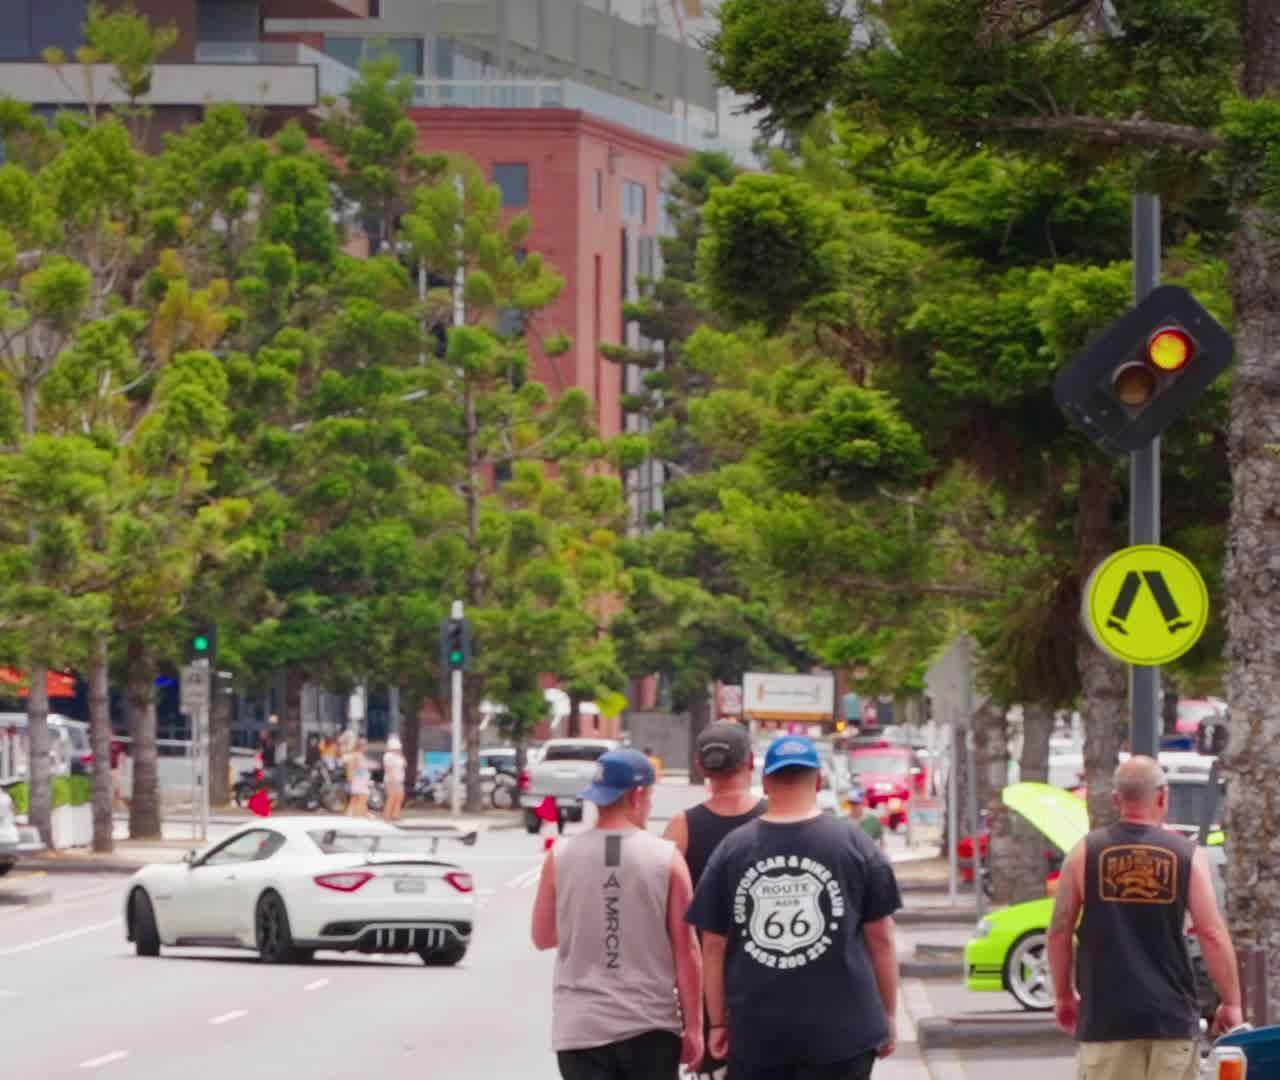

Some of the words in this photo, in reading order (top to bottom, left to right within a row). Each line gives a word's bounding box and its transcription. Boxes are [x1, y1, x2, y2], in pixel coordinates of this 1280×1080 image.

[756, 856, 786, 873] CAR
[826, 880, 844, 917] CLUB
[762, 883, 808, 895] ROUTE
[764, 908, 811, 939] 66
